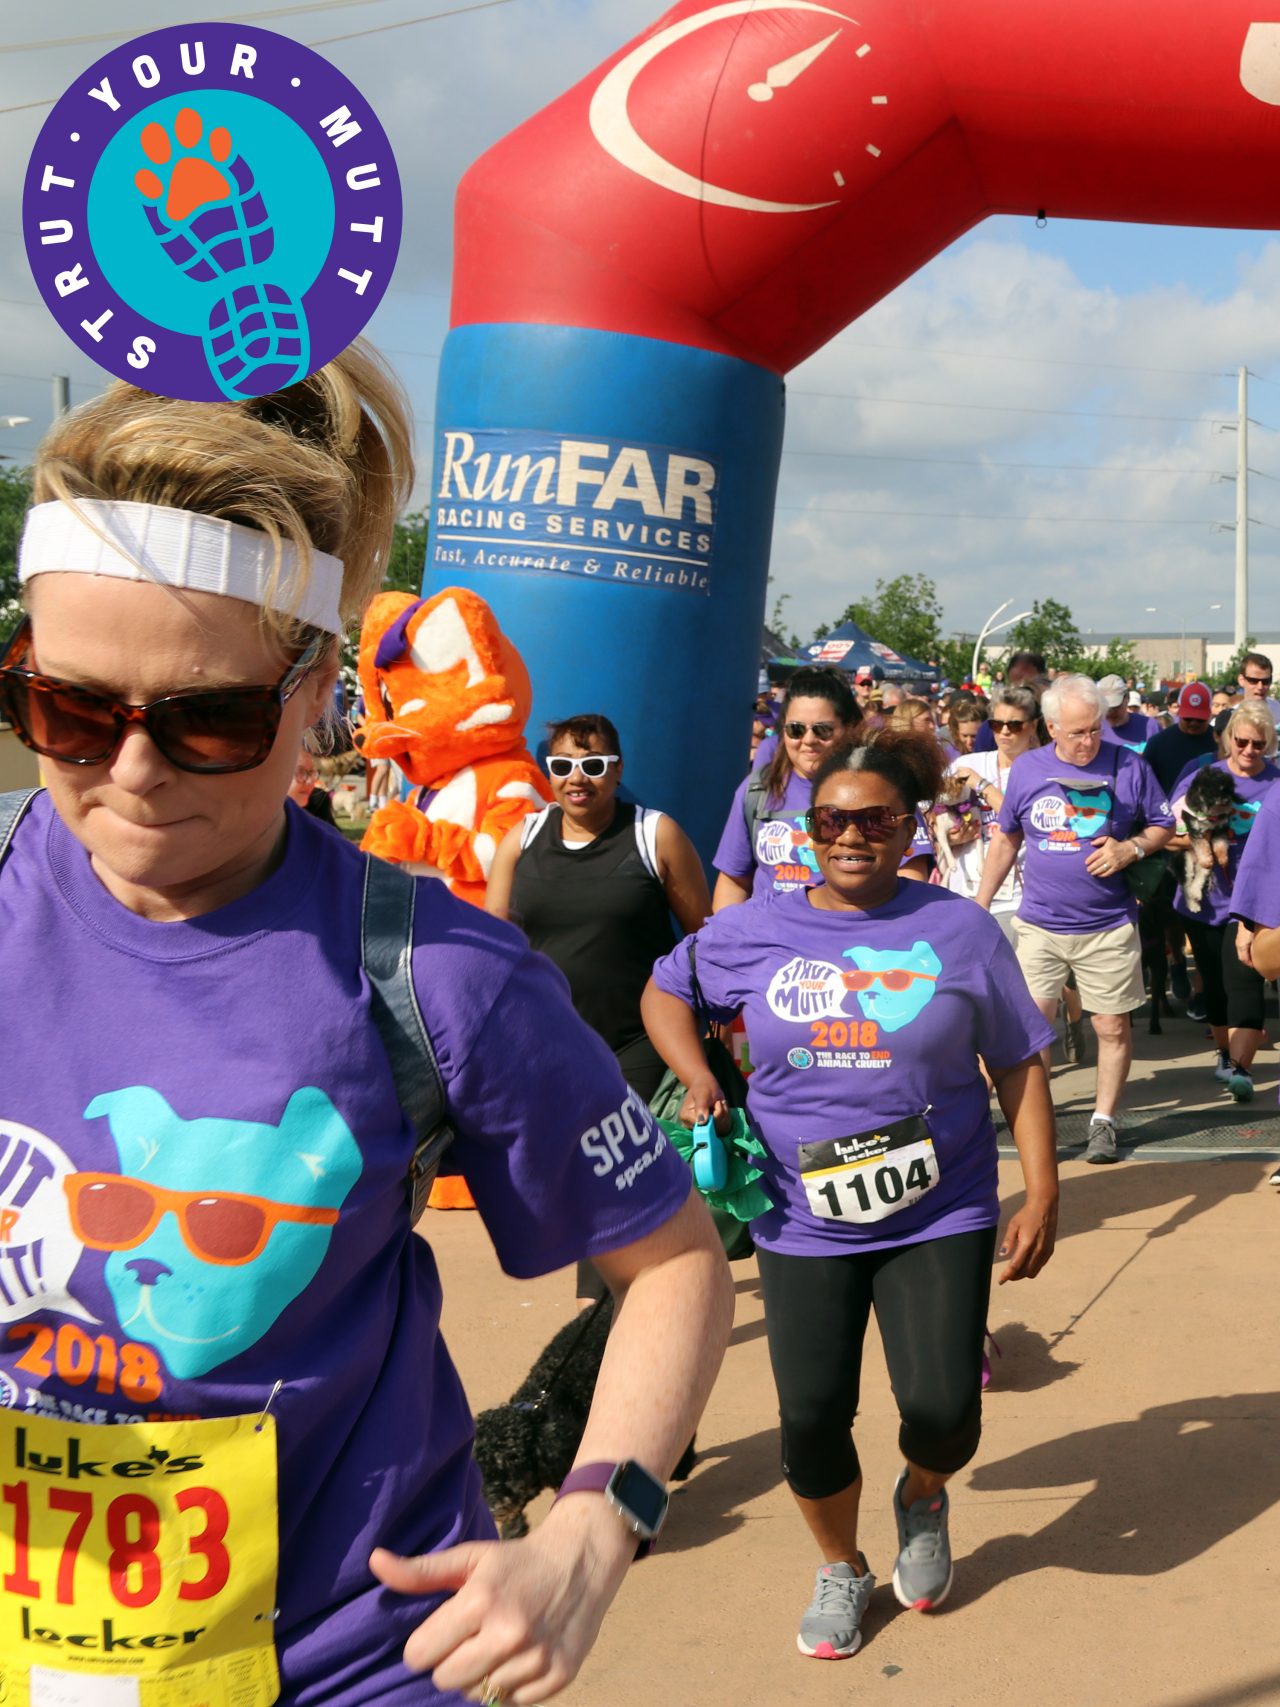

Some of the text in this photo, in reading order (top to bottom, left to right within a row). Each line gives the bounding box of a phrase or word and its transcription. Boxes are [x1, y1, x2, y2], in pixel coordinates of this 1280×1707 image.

[438, 431, 716, 525] RunFAR
[438, 508, 710, 552] RACING SERVICES
[435, 546, 707, 588] Fast, Accurate & Reliable
[774, 865, 810, 881] 2018
[774, 986, 834, 1017] MUTT!
[810, 1021, 878, 1047] 2018
[816, 1052, 832, 1060] THE
[835, 1052, 856, 1060] RACE
[859, 1052, 870, 1060] TO
[817, 1059, 892, 1068] ANIMAL CRUELTY
[818, 1157, 932, 1217] 1104
[7, 1323, 164, 1404] 2018
[15, 1427, 204, 1480] luke's
[3, 1480, 231, 1608] 1783
